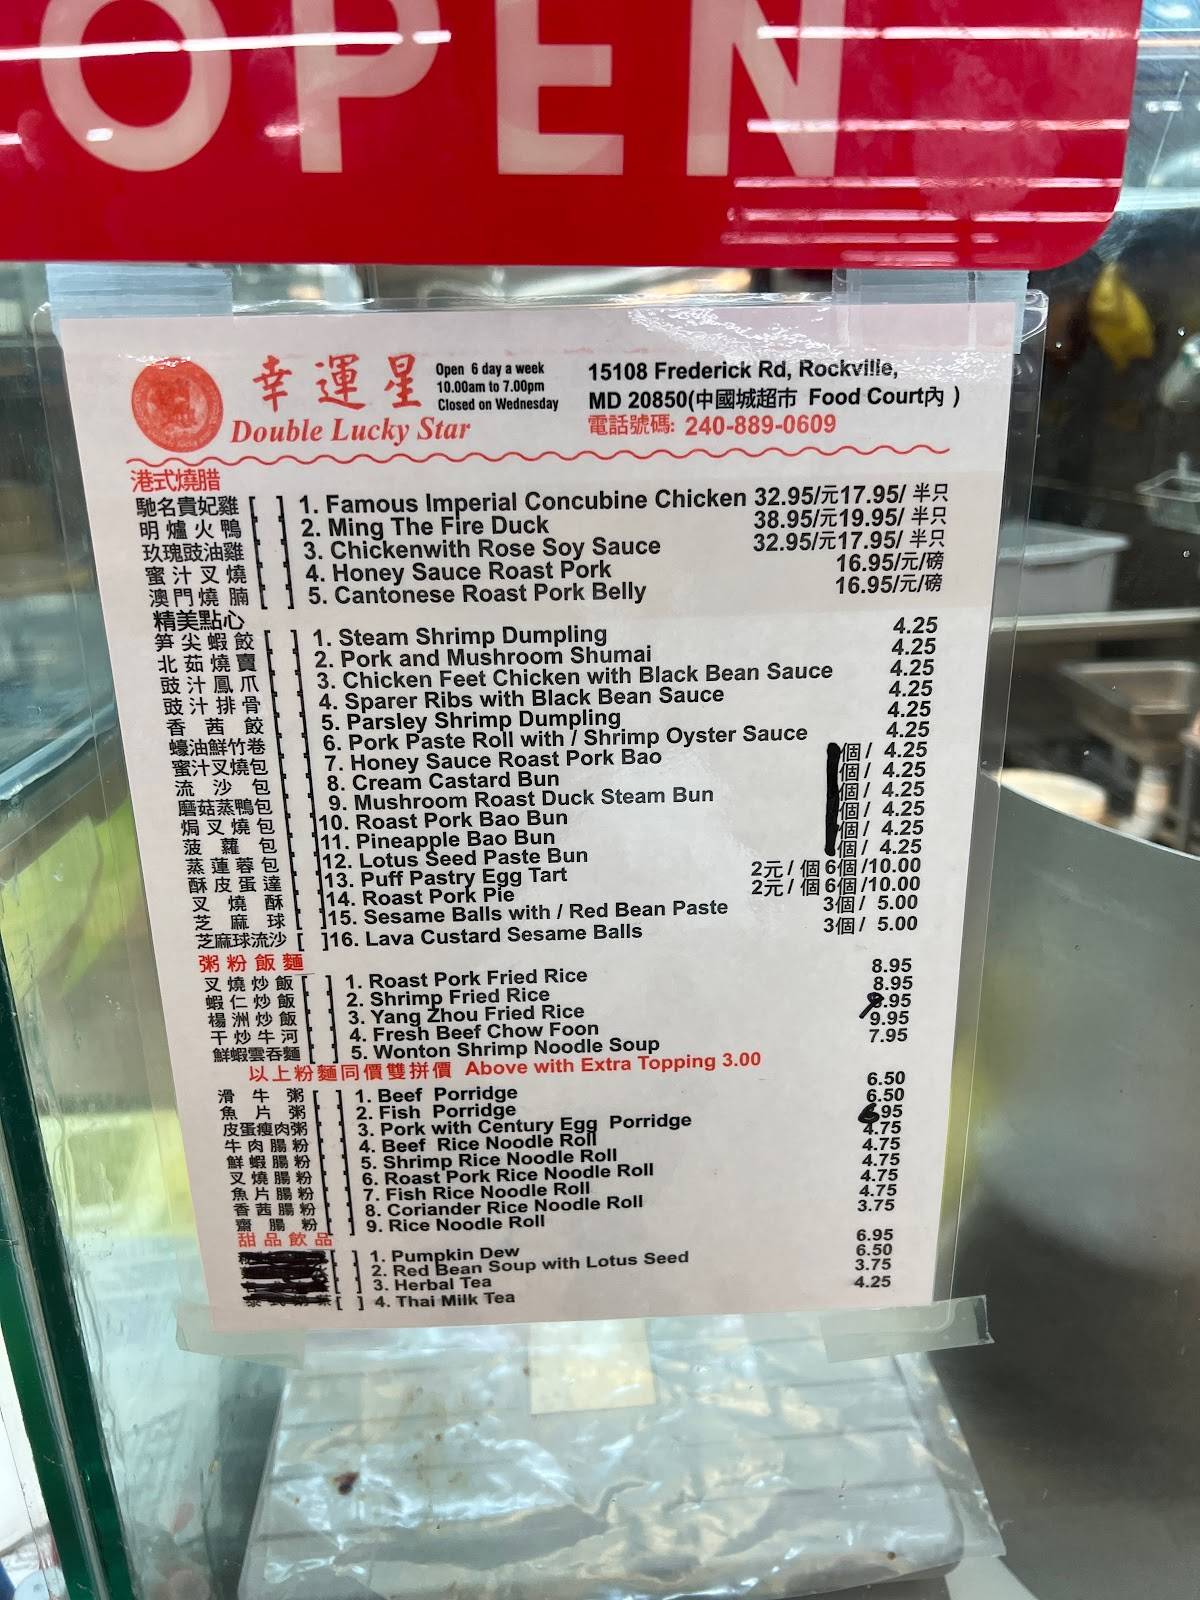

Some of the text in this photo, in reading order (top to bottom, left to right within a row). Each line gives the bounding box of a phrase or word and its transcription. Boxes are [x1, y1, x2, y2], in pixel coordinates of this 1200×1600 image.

[39, 0, 841, 176] OPEN
[436, 362, 544, 378] Open 6 day a week
[589, 358, 897, 381] 15108 Frederick Rd, Rockville,
[437, 380, 544, 394] 10.00am to 7.00pm
[438, 397, 558, 412] Closed on Wednesday
[590, 392, 621, 409] MD
[810, 388, 860, 405] Food
[232, 417, 470, 446] Double Lucky Star
[686, 414, 836, 435] 240-889-0609
[326, 488, 746, 516] Famous Imperial Concubine Chicken
[328, 515, 549, 541] Ming The Fire Duck
[331, 537, 660, 560] Chickenwith Rose Soy Sauce
[333, 560, 612, 586] Honey Sauce Roast Pork
[335, 582, 646, 604] Cantonese Roast Pork Belly
[893, 616, 938, 634] 4.25
[339, 625, 606, 648] Steam Shrimp Dumpling
[341, 645, 651, 668] Pork and Mushroom Shumai
[345, 686, 724, 714] Sparer Ribs with Black Bean Sauce
[347, 709, 620, 733] Parsley Shrimp Dumpling
[351, 749, 662, 774] Honey Sauce Roast Pork Bao
[352, 771, 559, 791] Cream Castard Bun
[356, 830, 554, 852] Pineapple Bao Bun
[360, 848, 587, 868] Lotus Seed Paste Bun
[361, 867, 567, 889] Puff Pastry Egg Tart
[878, 916, 917, 931] 5.00
[366, 924, 642, 946] Lava Custard Sesame Balls
[369, 968, 587, 988] Roast Pork Fried Rice
[370, 988, 550, 1010] Shrimp Fried Rice
[870, 1011, 909, 1026] 9.95
[373, 1022, 598, 1042] Fresh Beef Chow Foon
[869, 1028, 907, 1042] 7.95
[373, 1038, 660, 1059] Wonton Shrimp Noodle Soup
[465, 1061, 528, 1075] Above
[534, 1059, 574, 1073] with
[582, 1058, 631, 1072] Extra
[638, 1054, 715, 1072] Topping
[723, 1052, 760, 1066] 3.00
[868, 1071, 905, 1086] 6.50
[380, 1103, 516, 1120] Fish Porridge
[380, 1114, 691, 1136] Pork with Century Egg Porridge
[862, 1153, 900, 1166] 4.75
[388, 1195, 642, 1216] Coriander Rice Noodle Roll
[857, 1229, 893, 1241] 6.95
[393, 1251, 688, 1276] Red Bean Soup with Lotus Seed
[395, 1276, 492, 1291] Herbal Tea
[854, 1276, 890, 1288] 4.25
[396, 1292, 515, 1307] Thai Milk Tea
